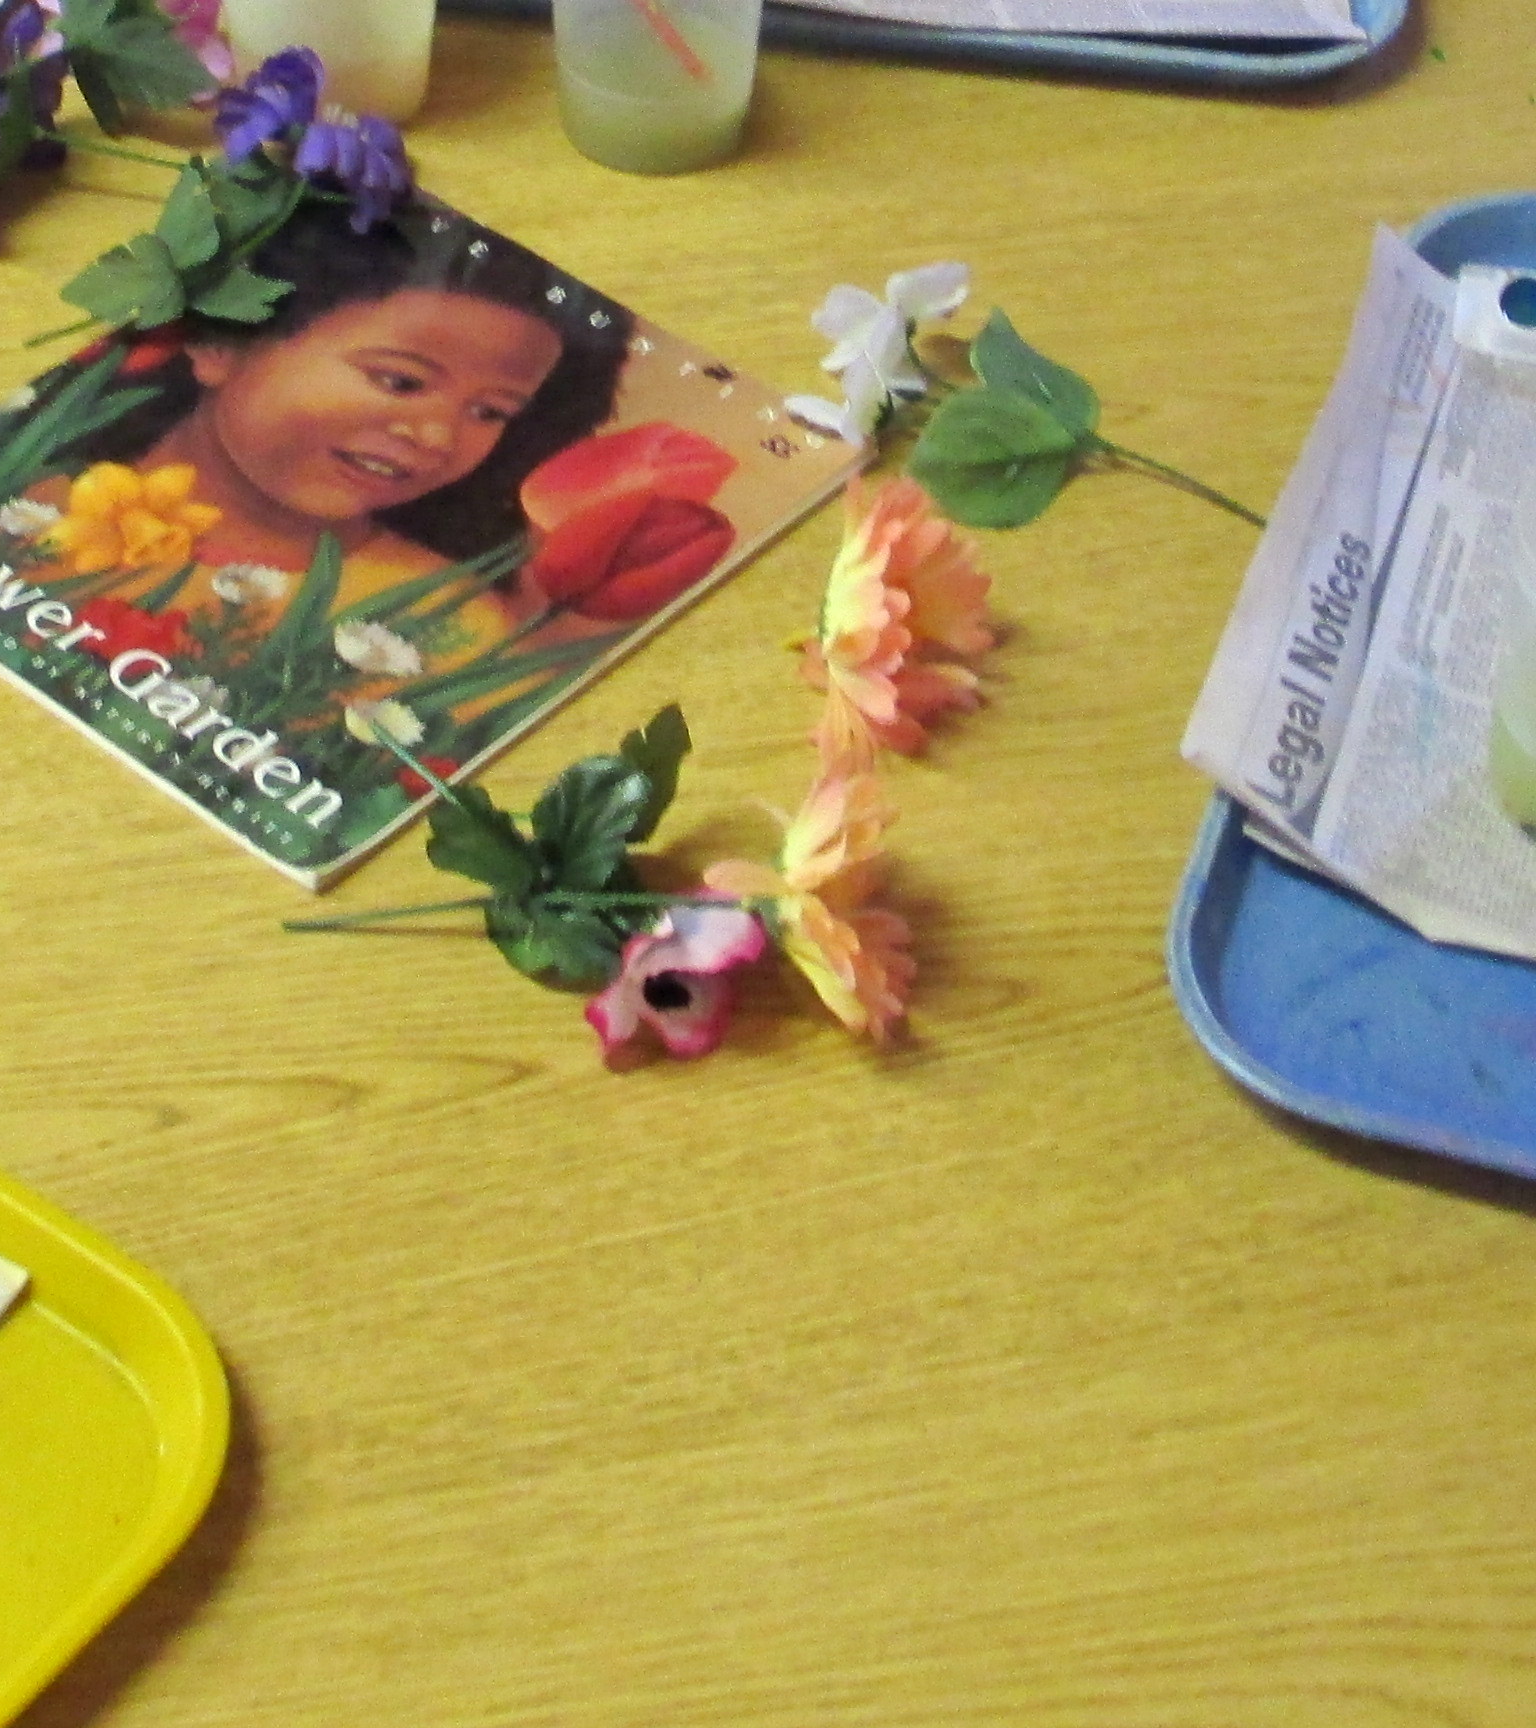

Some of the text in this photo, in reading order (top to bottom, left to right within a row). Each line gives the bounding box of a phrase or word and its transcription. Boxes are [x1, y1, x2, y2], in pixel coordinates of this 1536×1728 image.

[108, 647, 344, 830] Garden
[1248, 529, 1371, 808] Legal Notices
